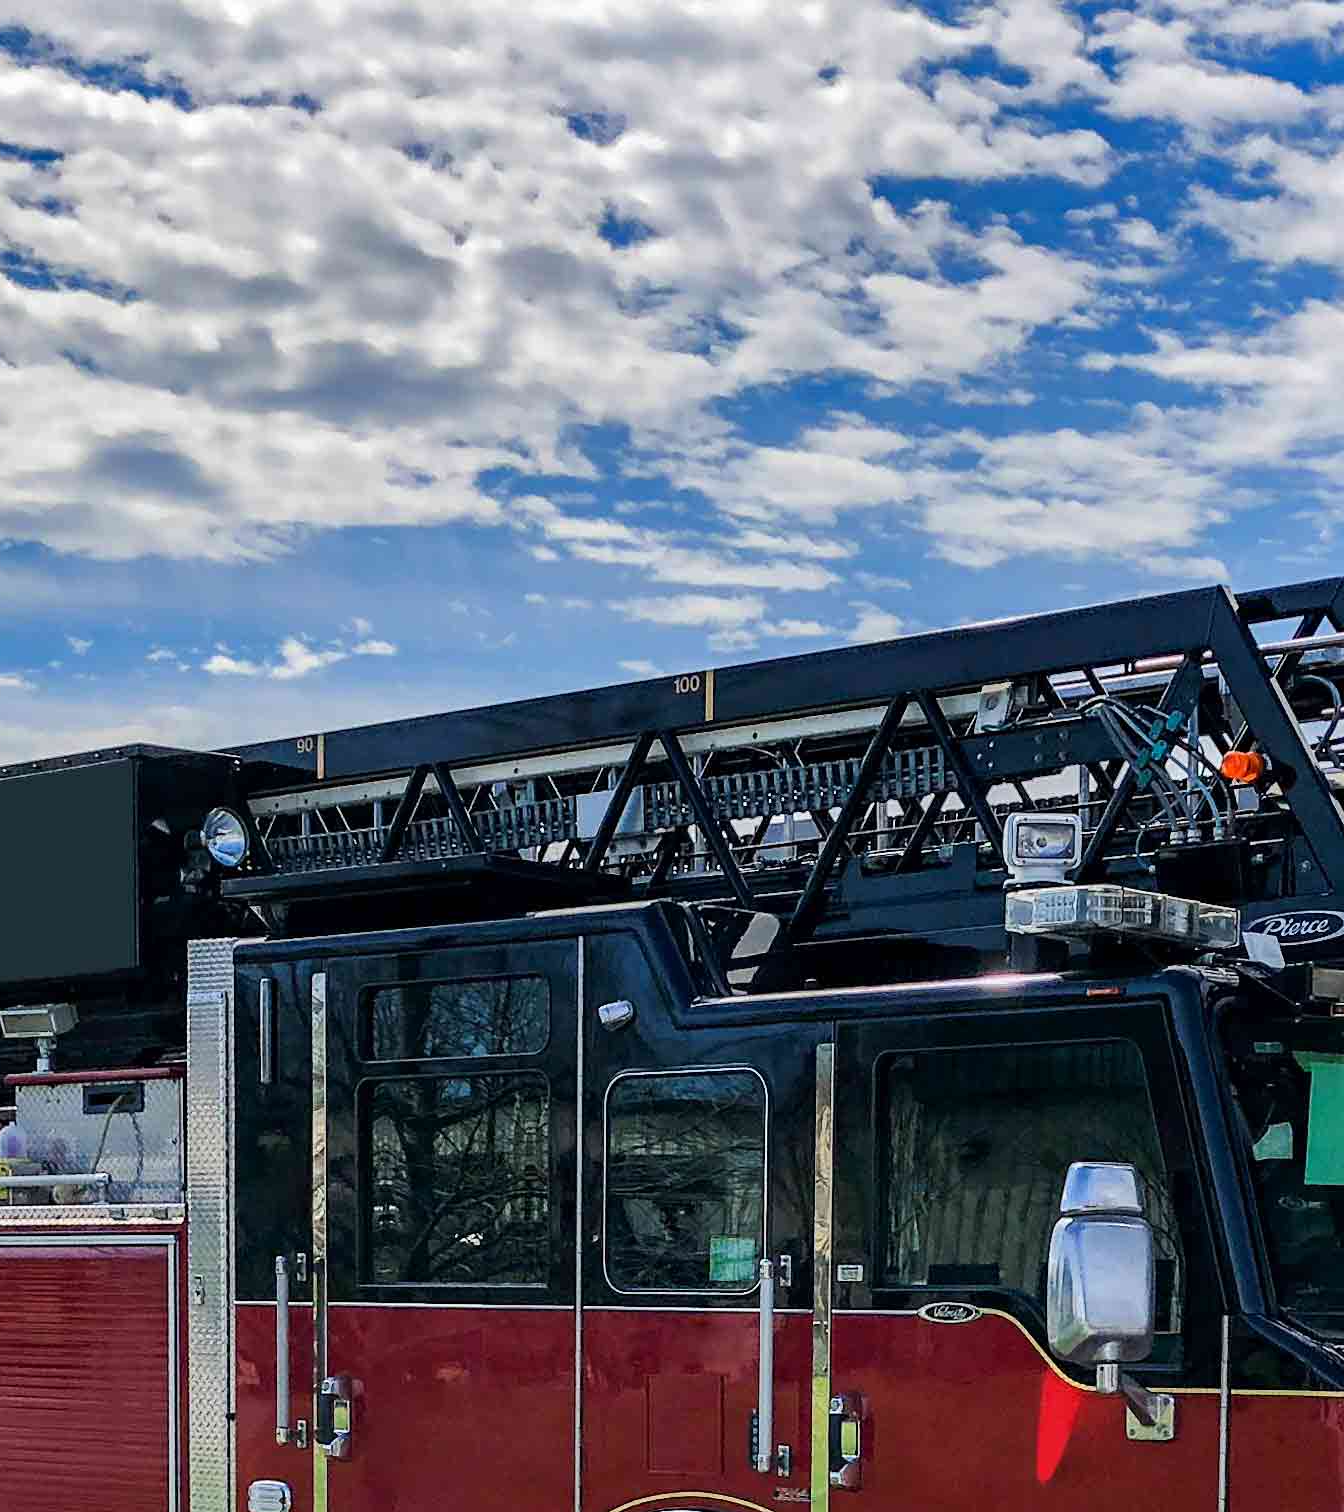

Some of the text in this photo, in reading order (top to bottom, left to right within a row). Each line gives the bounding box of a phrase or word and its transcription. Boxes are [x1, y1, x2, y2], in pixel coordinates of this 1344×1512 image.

[674, 675, 700, 694] 100
[297, 737, 313, 753] 90
[1263, 918, 1330, 937] Pierce
